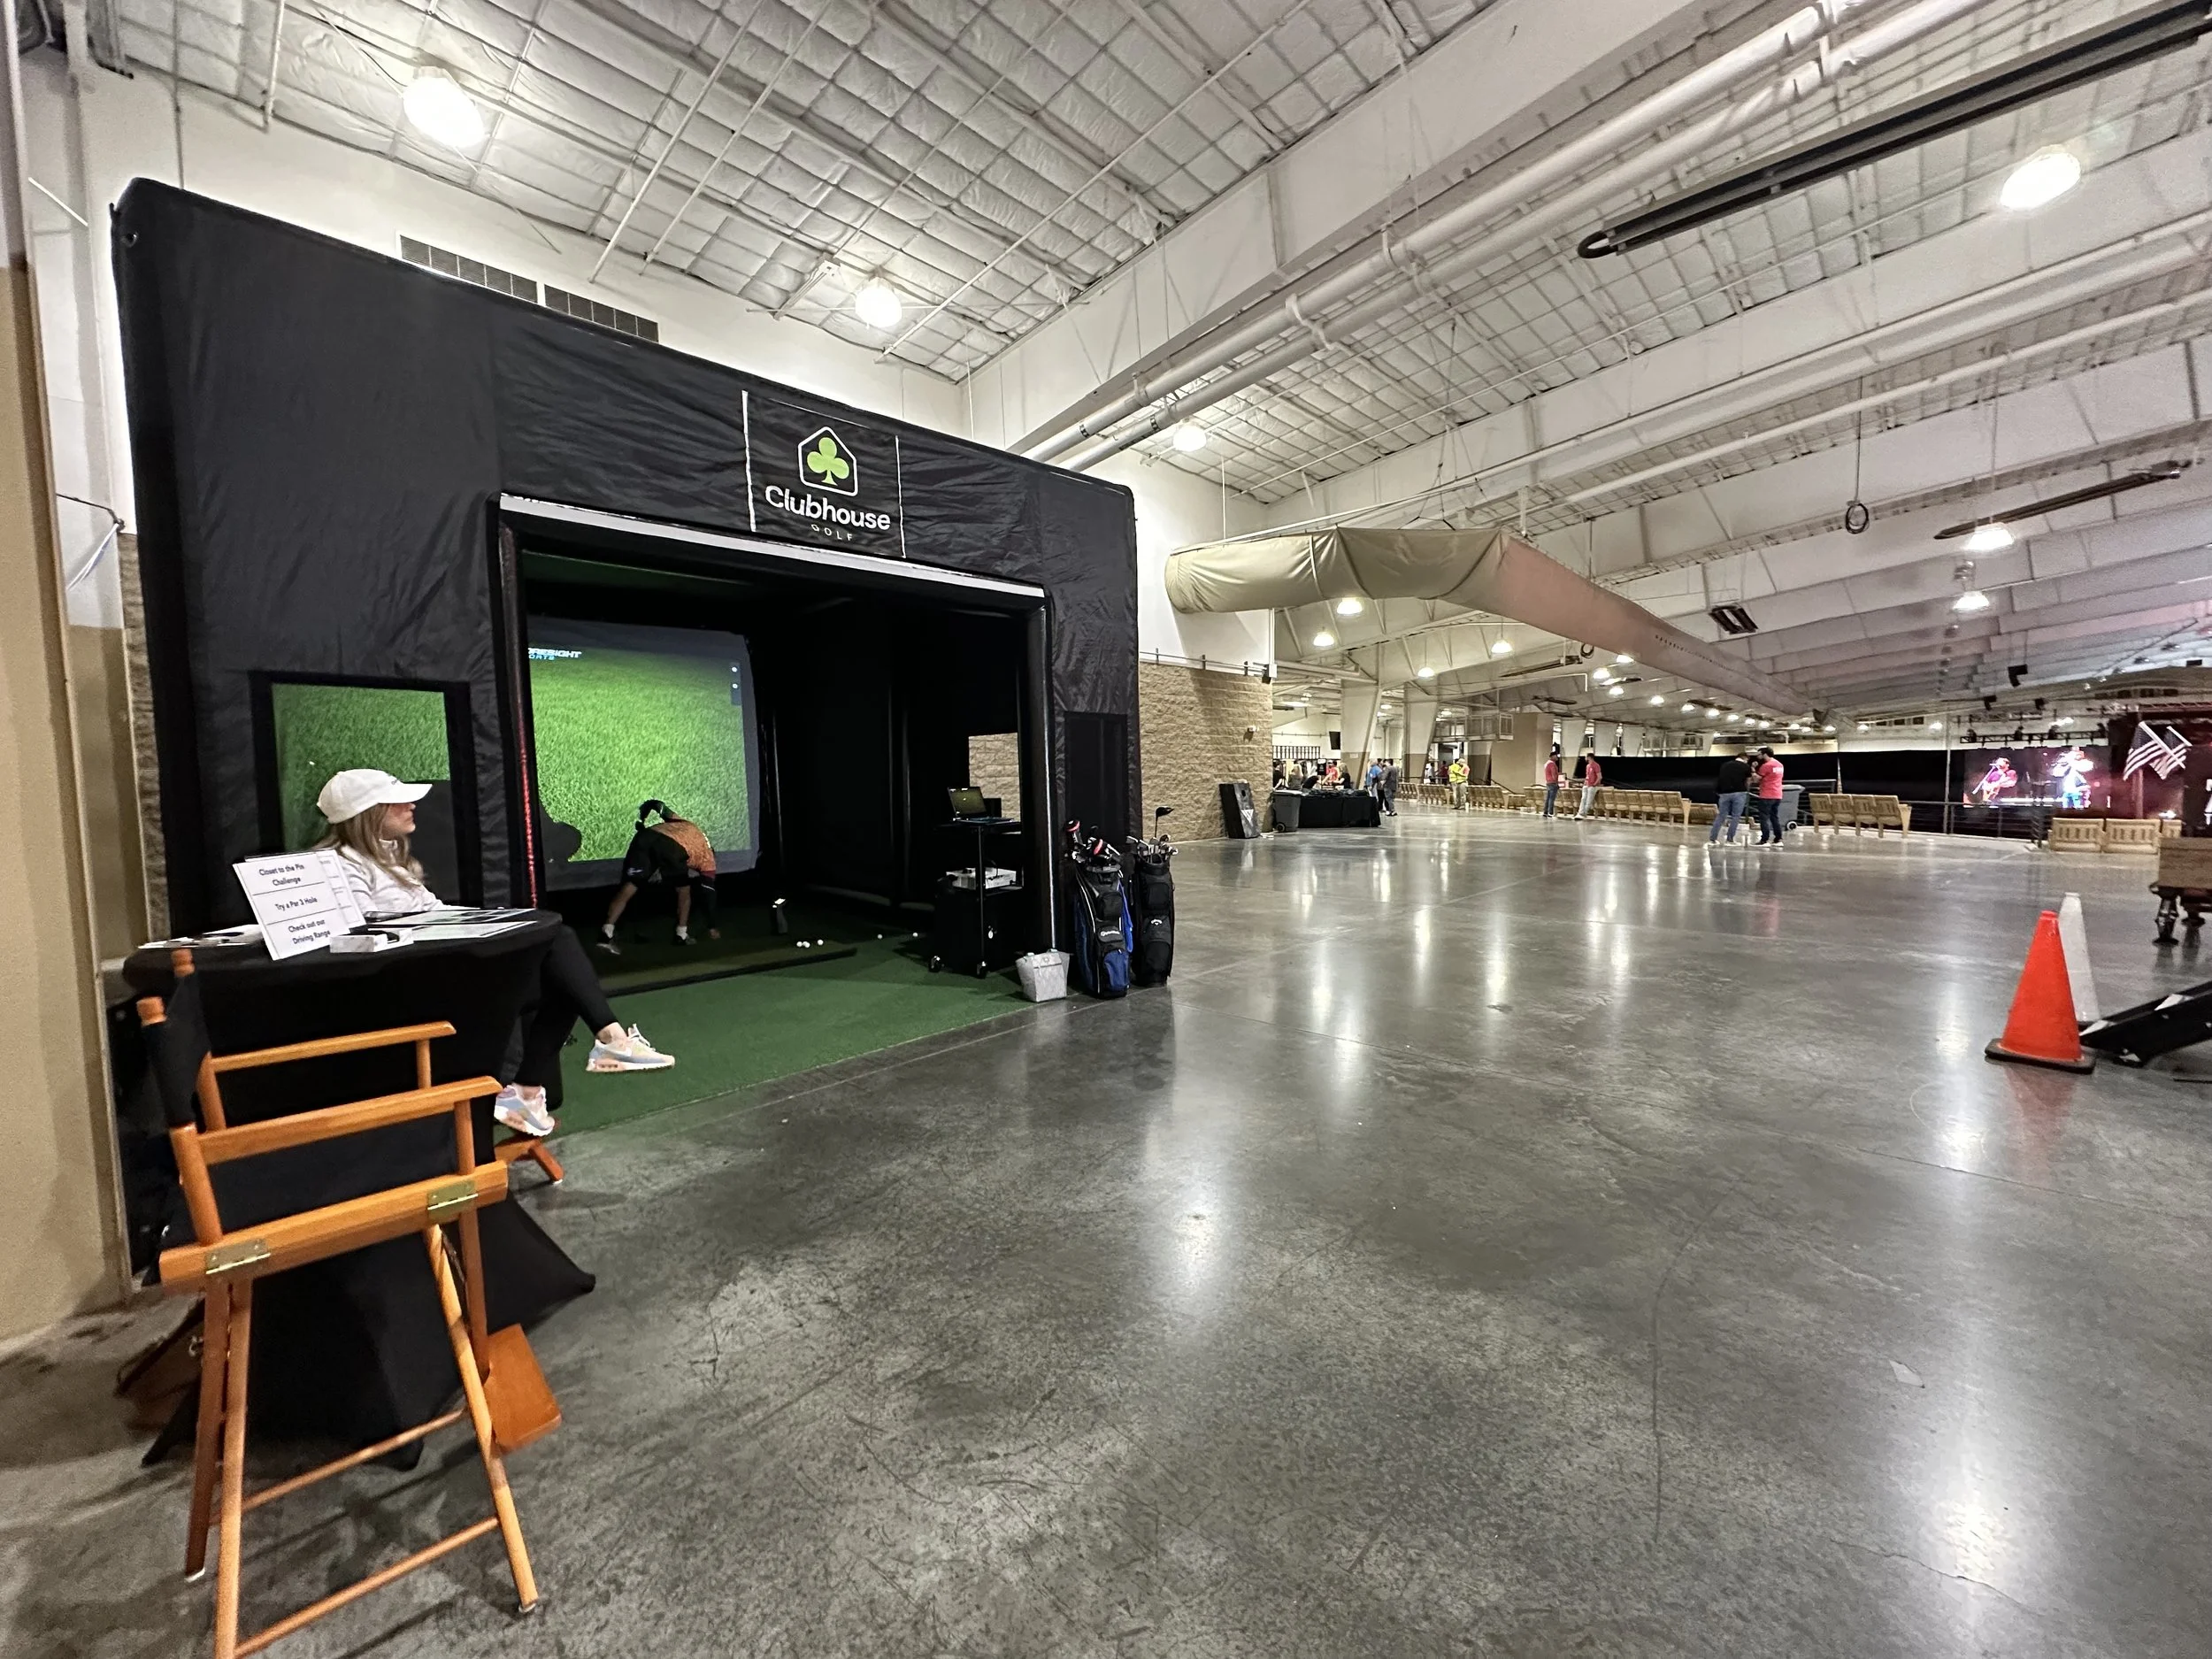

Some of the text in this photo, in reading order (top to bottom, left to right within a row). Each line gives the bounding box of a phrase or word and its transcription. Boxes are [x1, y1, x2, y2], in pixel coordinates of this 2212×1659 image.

[765, 485, 891, 530] Clubhouse
[811, 524, 853, 541] GOLF
[528, 648, 582, 658] ORESIGHT
[272, 877, 301, 886] Challenge
[288, 923, 306, 933] Check
[292, 934, 314, 944] Driving
